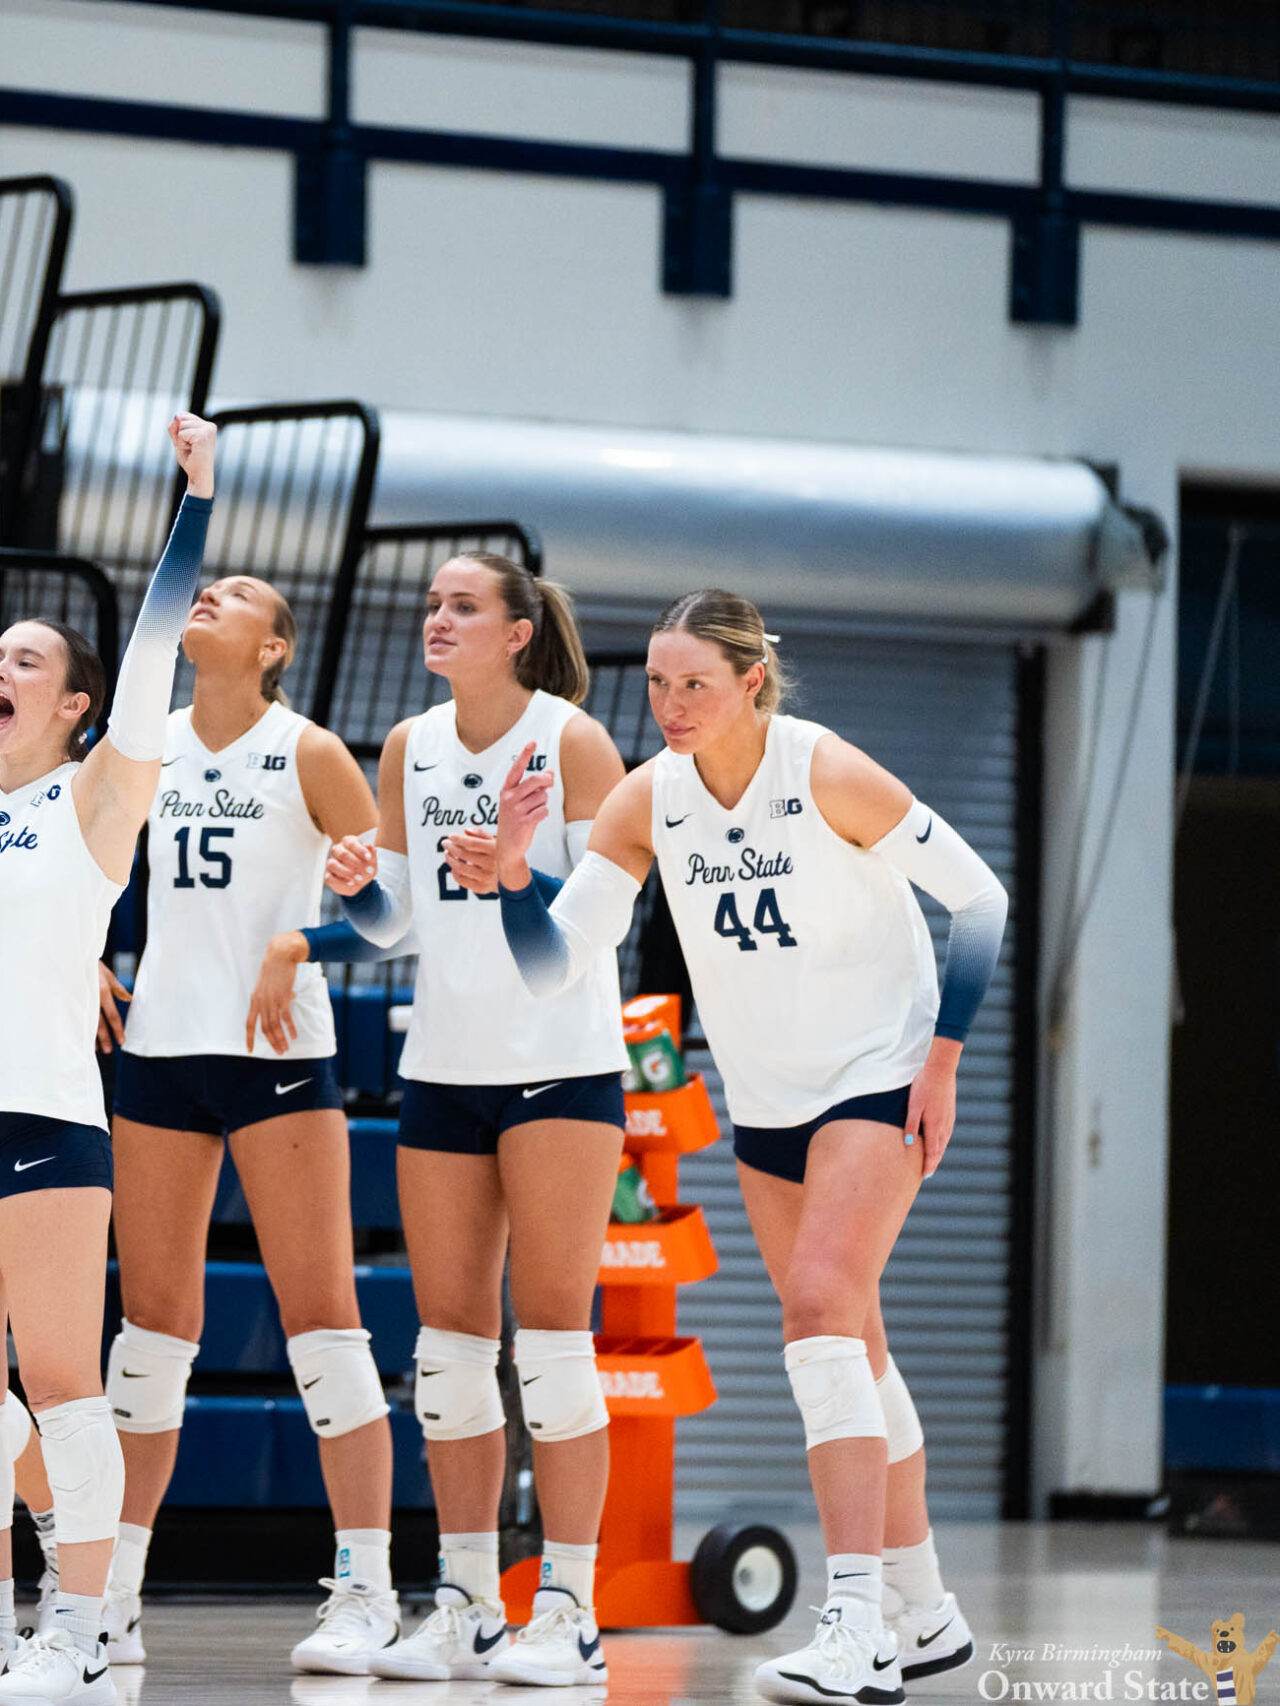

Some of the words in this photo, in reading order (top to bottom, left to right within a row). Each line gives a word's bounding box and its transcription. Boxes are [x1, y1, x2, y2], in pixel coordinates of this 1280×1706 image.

[159, 790, 206, 819] Penn
[207, 789, 265, 820] State
[421, 795, 467, 827] Penn
[173, 826, 236, 890] 15
[685, 852, 735, 887] Penn
[738, 847, 795, 882] State
[713, 888, 799, 952] 44
